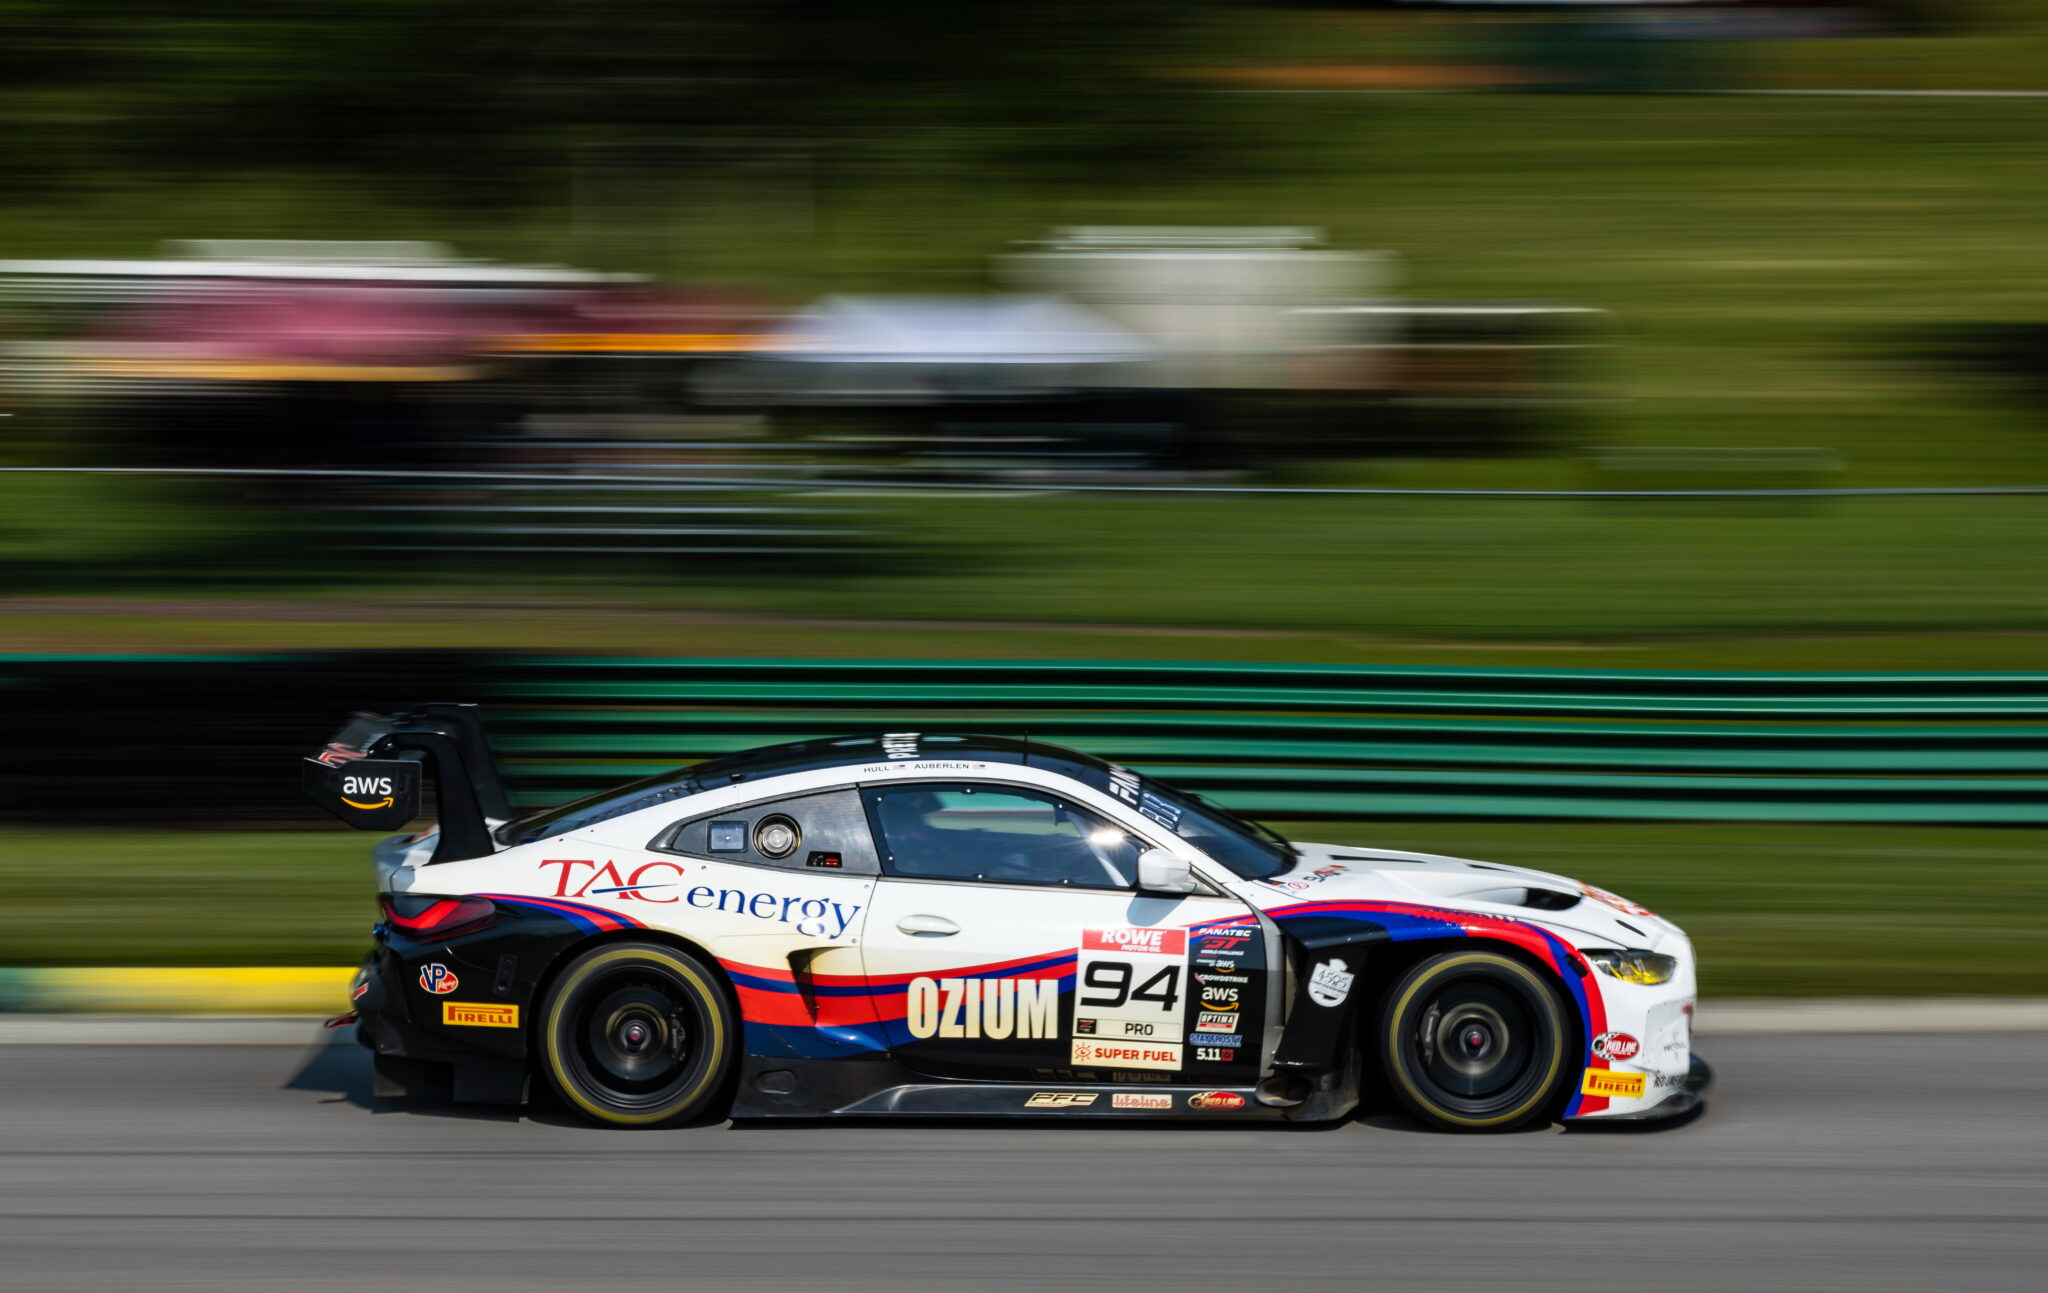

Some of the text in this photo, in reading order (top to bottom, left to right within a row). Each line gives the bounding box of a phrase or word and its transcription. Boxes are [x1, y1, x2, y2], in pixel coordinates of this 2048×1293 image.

[343, 776, 392, 795] aws
[538, 859, 861, 940] TAC energy
[1101, 929, 1164, 945] ROWE
[1198, 928, 1252, 937] FANATEC
[420, 963, 448, 993] VP
[1080, 961, 1180, 1011] 94
[1199, 974, 1248, 983] CROWDSTRIKE
[1201, 986, 1239, 1002] aws
[448, 1005, 513, 1024] PIRELLI
[907, 976, 1059, 1040] OZIUM
[1201, 1014, 1234, 1024] OPTIMA
[1124, 1022, 1154, 1036] PRO
[1094, 1047, 1177, 1062] SUPER FUEL
[1196, 1047, 1221, 1061] 5.11
[1589, 1074, 1642, 1094] PIRELLI
[1031, 1093, 1097, 1103] PFC
[1115, 1095, 1172, 1107] lifeline
